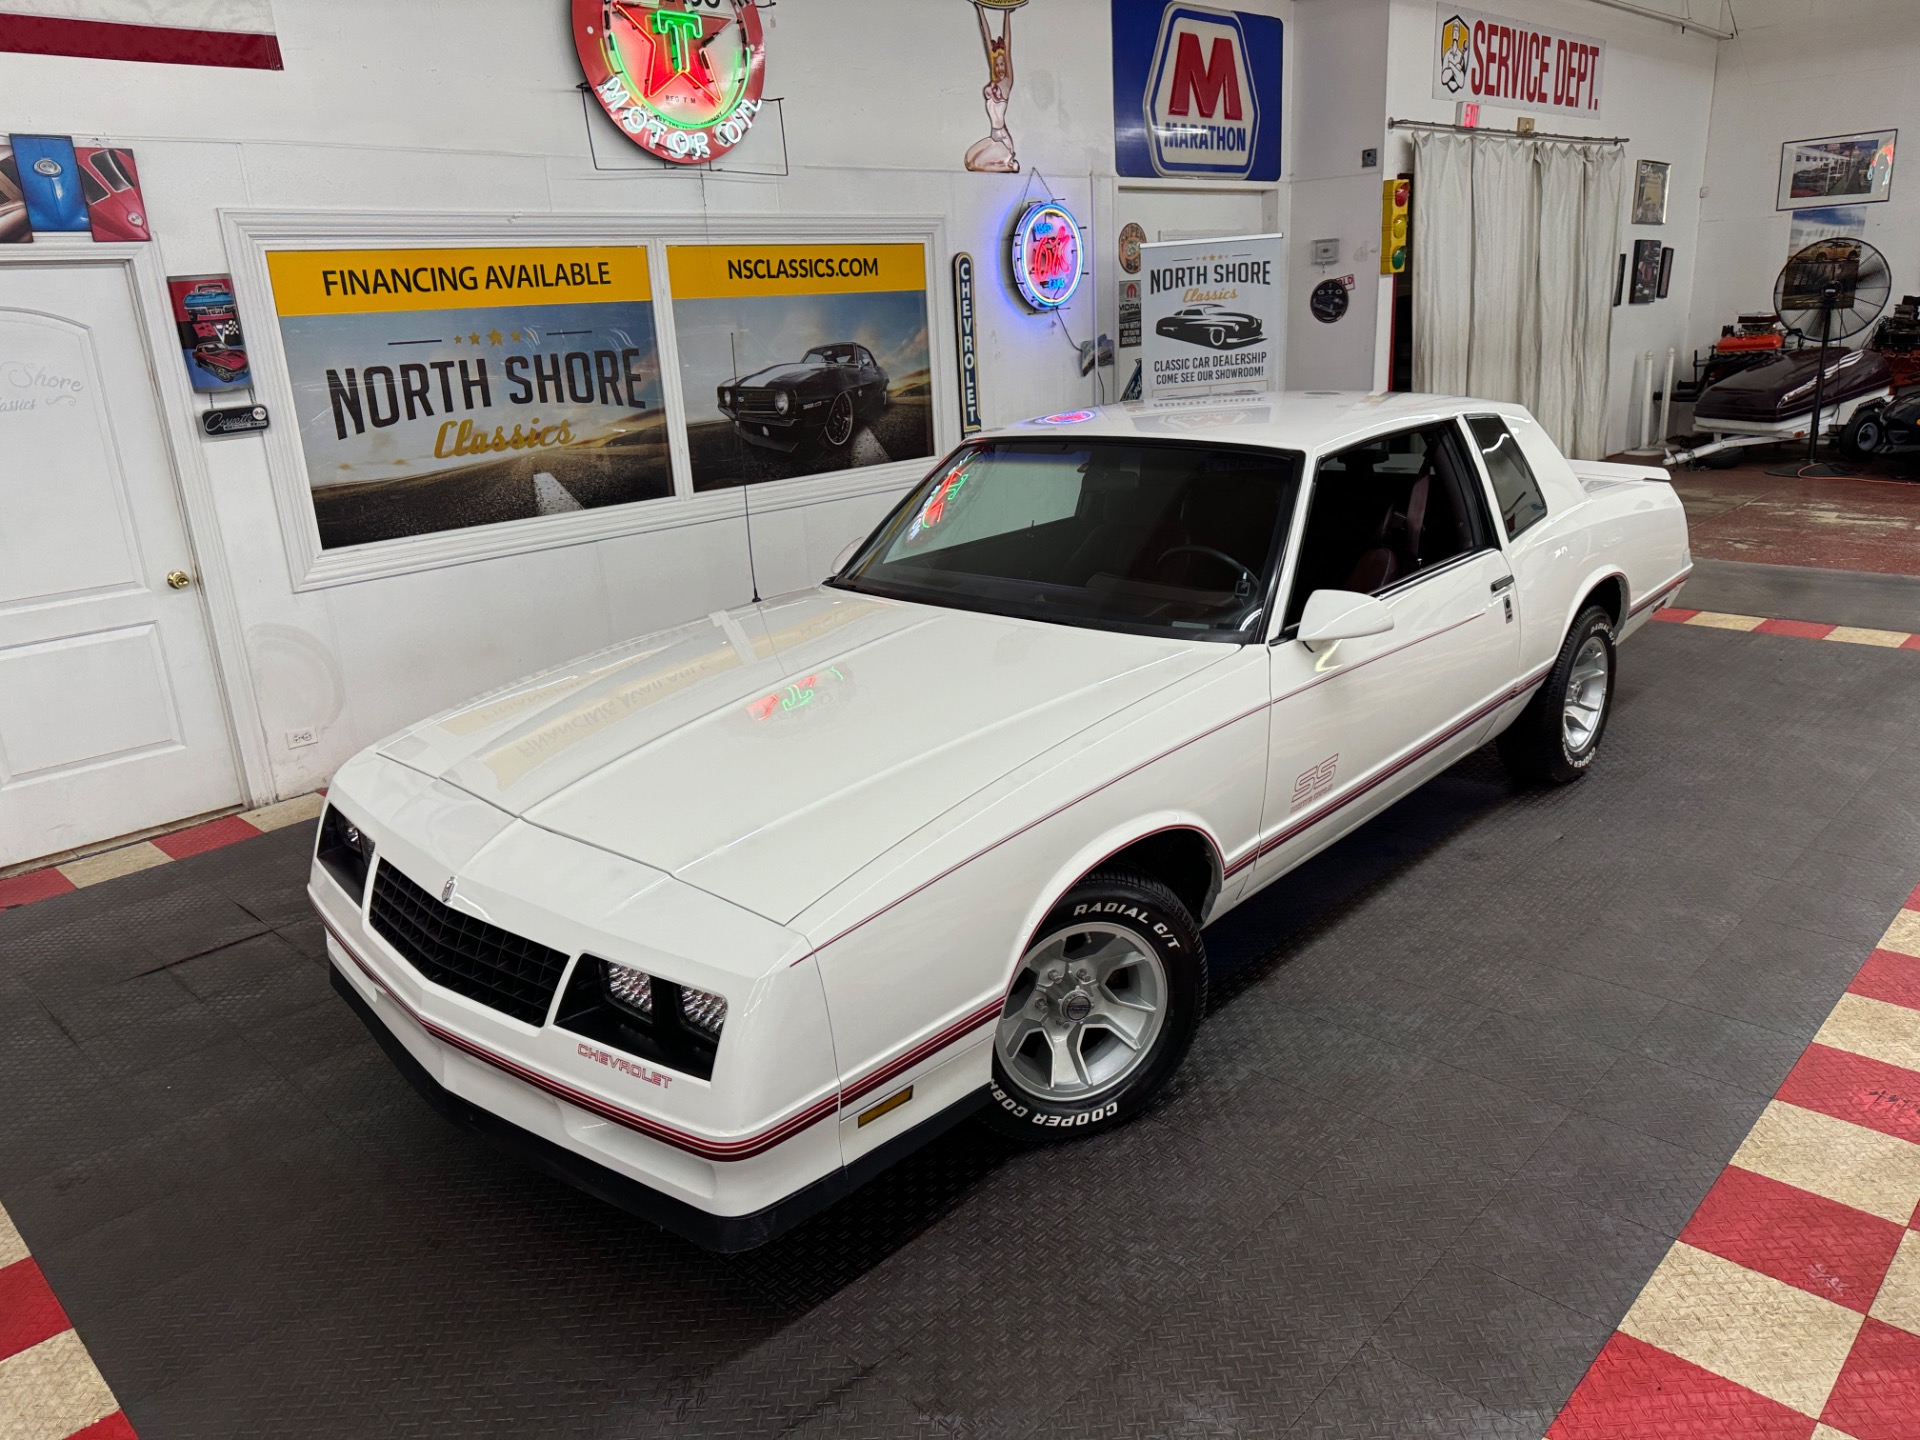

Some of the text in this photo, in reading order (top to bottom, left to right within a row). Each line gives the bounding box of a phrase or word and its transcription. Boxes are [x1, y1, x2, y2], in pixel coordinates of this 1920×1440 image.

[1168, 32, 1242, 121] M
[1471, 20, 1600, 111] SERVICE DEPT.
[597, 76, 762, 158] MOTOR OIL
[1464, 104, 1479, 127] EXIT
[1164, 121, 1247, 152] MARATHON
[322, 262, 611, 297] FINANCING AVAILABLE
[727, 257, 879, 280] NSCLASSICS.COM
[1126, 257, 1140, 271] BE
[1150, 260, 1272, 295] NORTH SHORE
[1119, 303, 1140, 311] MOPA
[1182, 287, 1239, 303] Classics
[960, 263, 976, 423] CHEVROLET
[2, 361, 84, 392] Shore
[1154, 351, 1267, 373] CLASSIC CAR DEALERSHIP
[1156, 365, 1264, 385] COME SEE OUR SHOWROOM!
[325, 348, 647, 441] NORTH SHORE
[433, 417, 577, 459] Classics
[1291, 752, 1339, 803] SS
[1073, 901, 1181, 948] RADIAL G/T
[577, 1043, 673, 1089] CHEVROLET
[1031, 1101, 1118, 1127] COOPER
